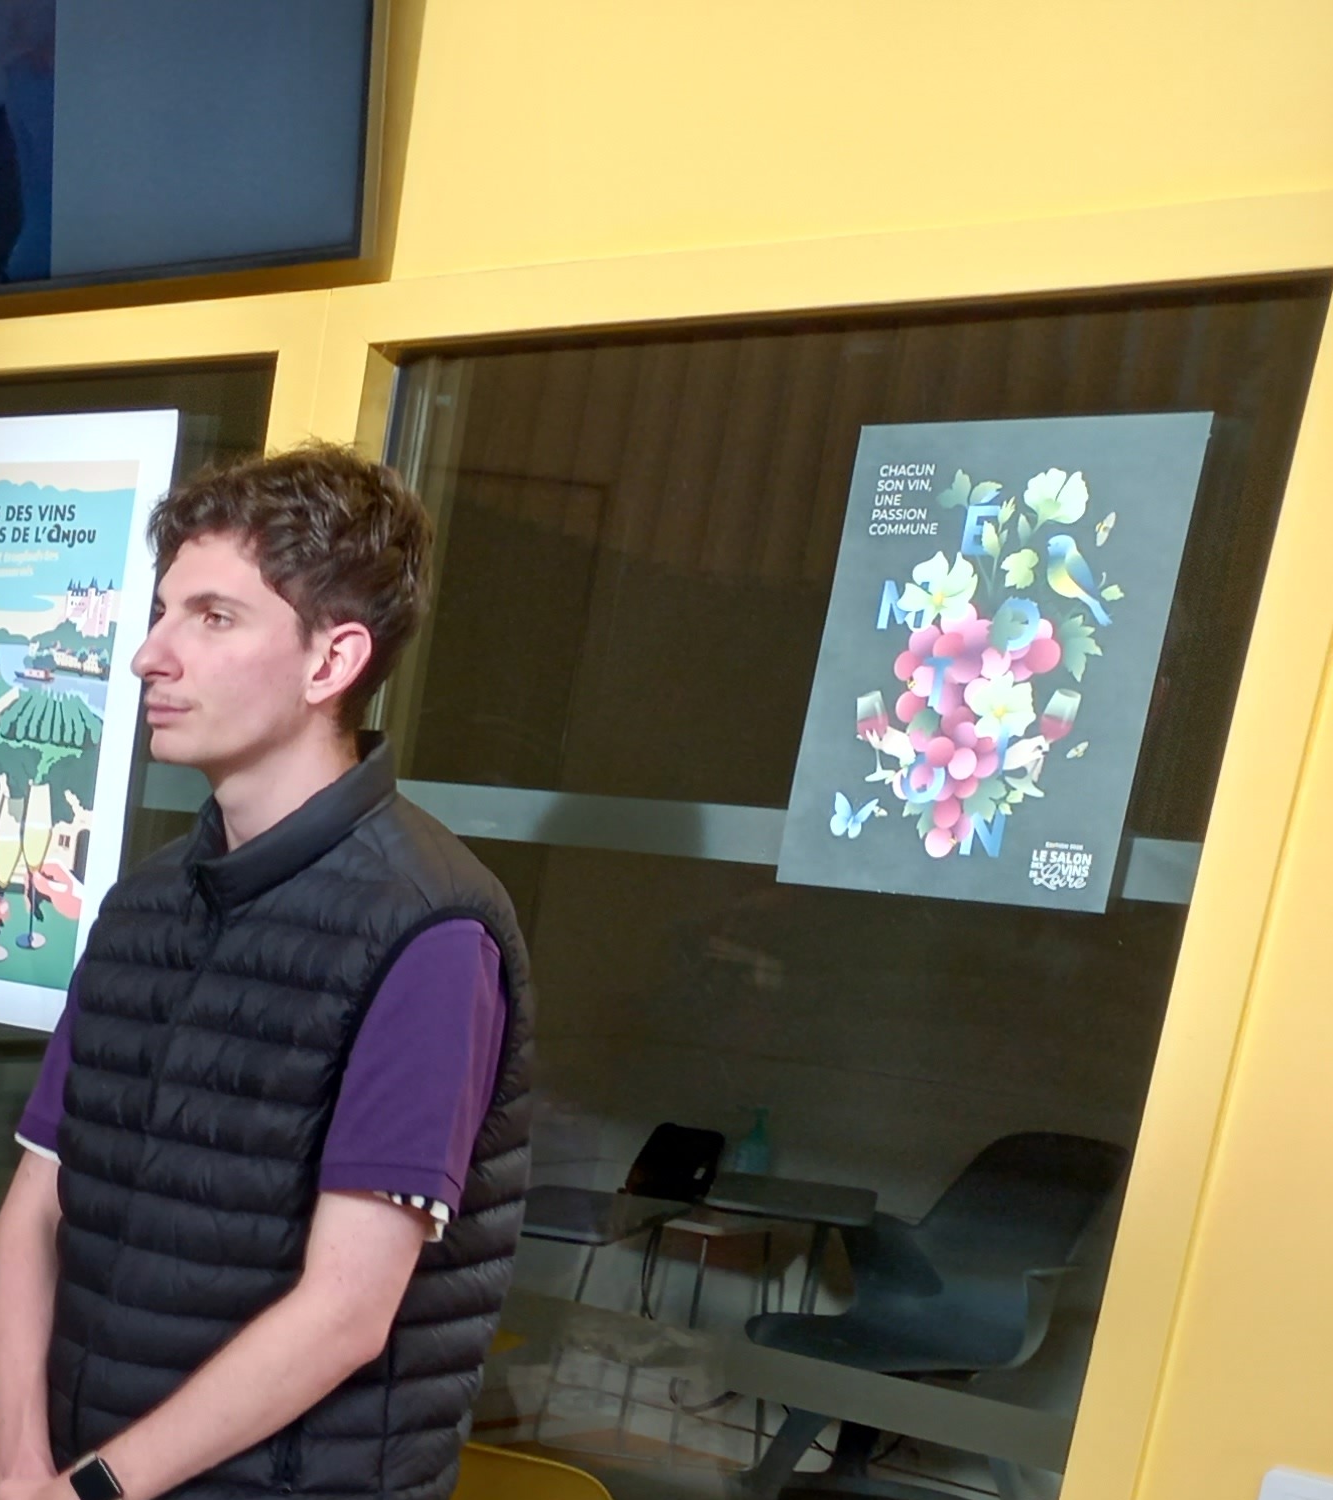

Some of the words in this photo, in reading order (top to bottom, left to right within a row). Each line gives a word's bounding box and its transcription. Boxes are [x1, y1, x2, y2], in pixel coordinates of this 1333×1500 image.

[880, 464, 935, 477] CHACUN
[877, 479, 904, 492] SON
[908, 479, 932, 492] VIN,
[875, 494, 902, 506] UNE
[5, 504, 33, 522] DES
[38, 504, 76, 522] VINS
[872, 508, 927, 520] PASSION
[11, 526, 30, 543] DE
[869, 523, 938, 535] COMMUNE
[1032, 849, 1048, 862] LE
[1049, 851, 1092, 866] SALON
[1061, 864, 1089, 877] VINS
[1033, 864, 1086, 891] Loire
